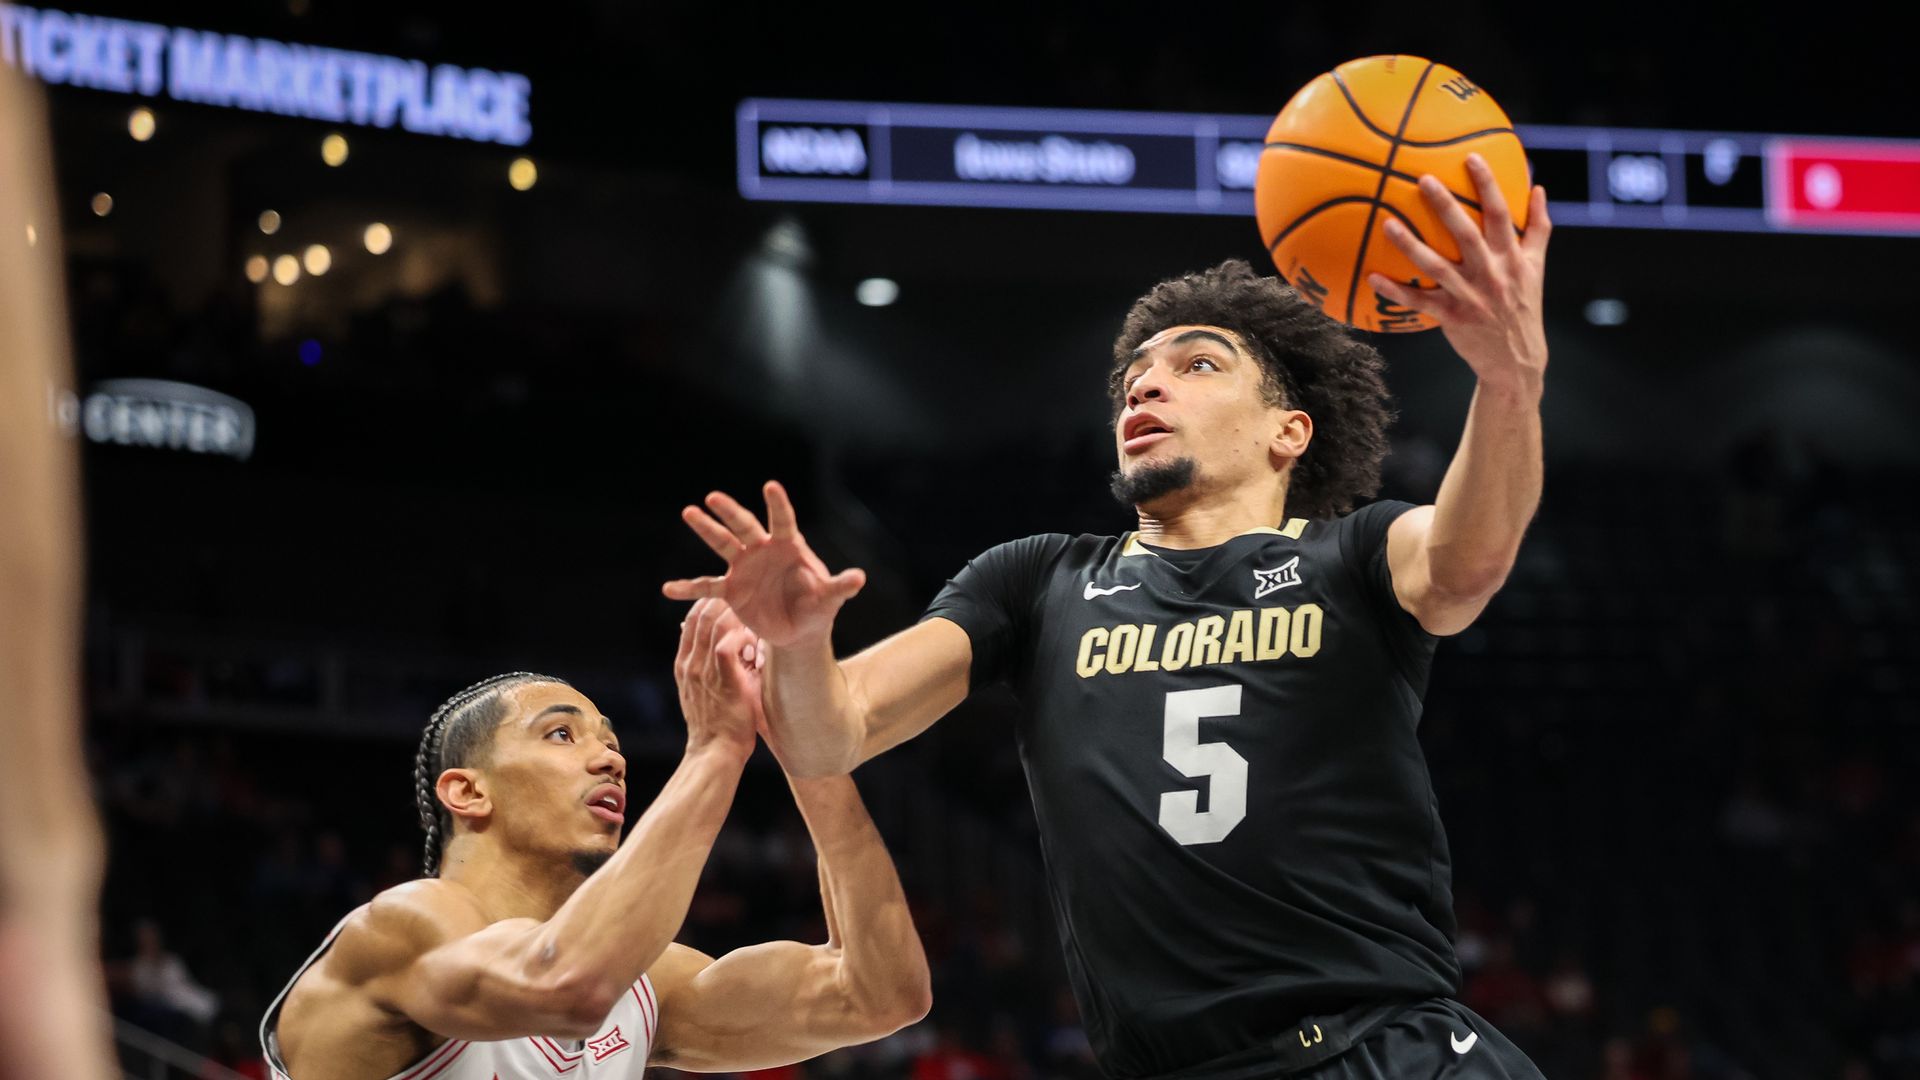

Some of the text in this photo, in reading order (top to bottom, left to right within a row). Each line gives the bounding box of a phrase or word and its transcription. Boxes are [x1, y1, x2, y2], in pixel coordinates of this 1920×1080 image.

[0, 3, 532, 146] TICKET MARKETPLACE
[84, 392, 242, 453] CENTER
[1256, 560, 1299, 596] XII
[1075, 603, 1323, 679] COLORADO
[1158, 684, 1249, 846] 5
